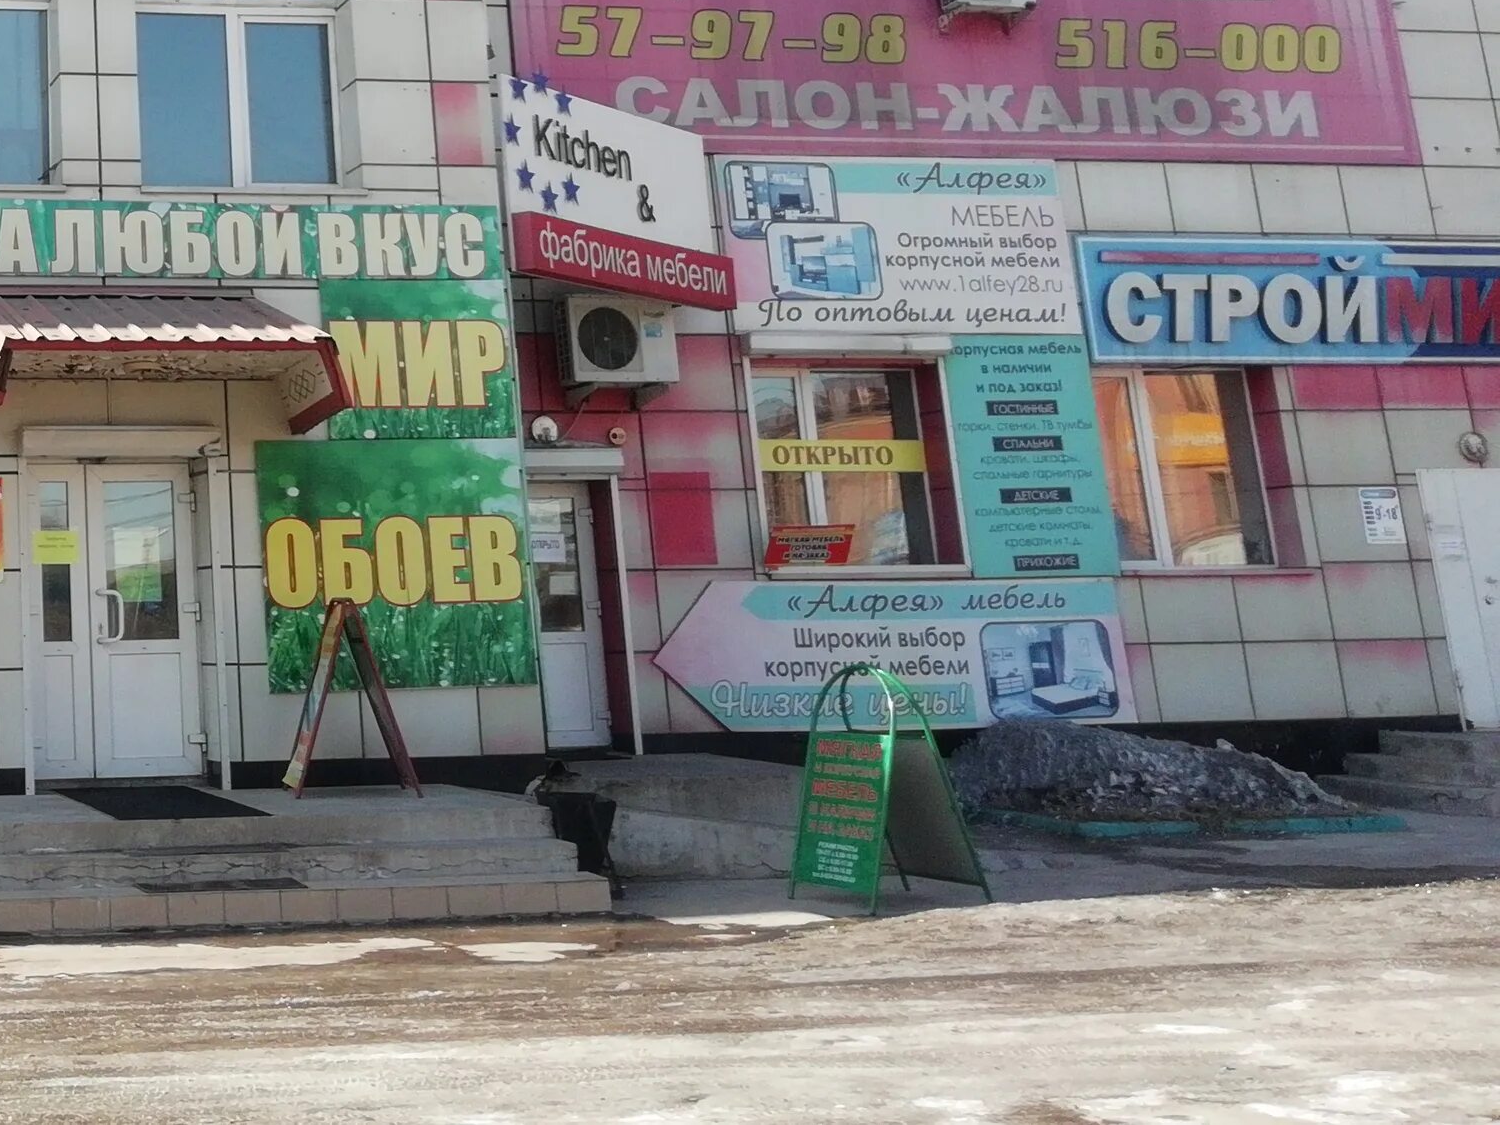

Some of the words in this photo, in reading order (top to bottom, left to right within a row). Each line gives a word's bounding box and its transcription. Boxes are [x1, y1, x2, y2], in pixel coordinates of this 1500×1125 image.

[555, 4, 907, 64] 57-97-98
[1055, 18, 1342, 73] 516-000
[615, 75, 1321, 138] САЛОН-ЖАЛЮЗИ
[532, 113, 633, 182] Kitchen
[896, 162, 1047, 195] «Алфея»
[636, 184, 657, 223] &
[951, 204, 1055, 228] МЕБЕЛЬ
[317, 210, 486, 278] ВКУС
[897, 231, 994, 251] Огромный
[999, 232, 1057, 251] выбор
[539, 221, 642, 279] фабрика
[646, 252, 728, 296] мебели
[885, 252, 986, 272] корпусной
[990, 251, 1060, 268] мебели
[758, 297, 803, 328] По
[814, 299, 955, 325] оптовым
[965, 302, 1066, 328] ценам!
[1028, 342, 1082, 354] мебель
[329, 319, 506, 408] МИР
[980, 365, 989, 374] в
[992, 363, 1052, 373] наличии
[976, 384, 985, 393] и
[988, 384, 1016, 394] под
[1020, 379, 1063, 393] заказ!
[993, 403, 1055, 414] ГОСТИННЫЕ
[772, 445, 894, 465] ОТКРЫТО
[1002, 439, 1055, 450] СПАЛЬНИ
[1013, 490, 1060, 502] ДЕТСКИЕ
[264, 515, 524, 609] ОБОЕВ
[1016, 555, 1077, 568] ПРИХОЖИЕ
[787, 585, 944, 619] «Алфея»
[961, 584, 1067, 611] мебель
[793, 625, 891, 654] Широкий
[898, 627, 966, 649] выбор
[888, 656, 971, 677] мебели
[710, 681, 855, 720] Низкие
[867, 680, 969, 726] цены!
